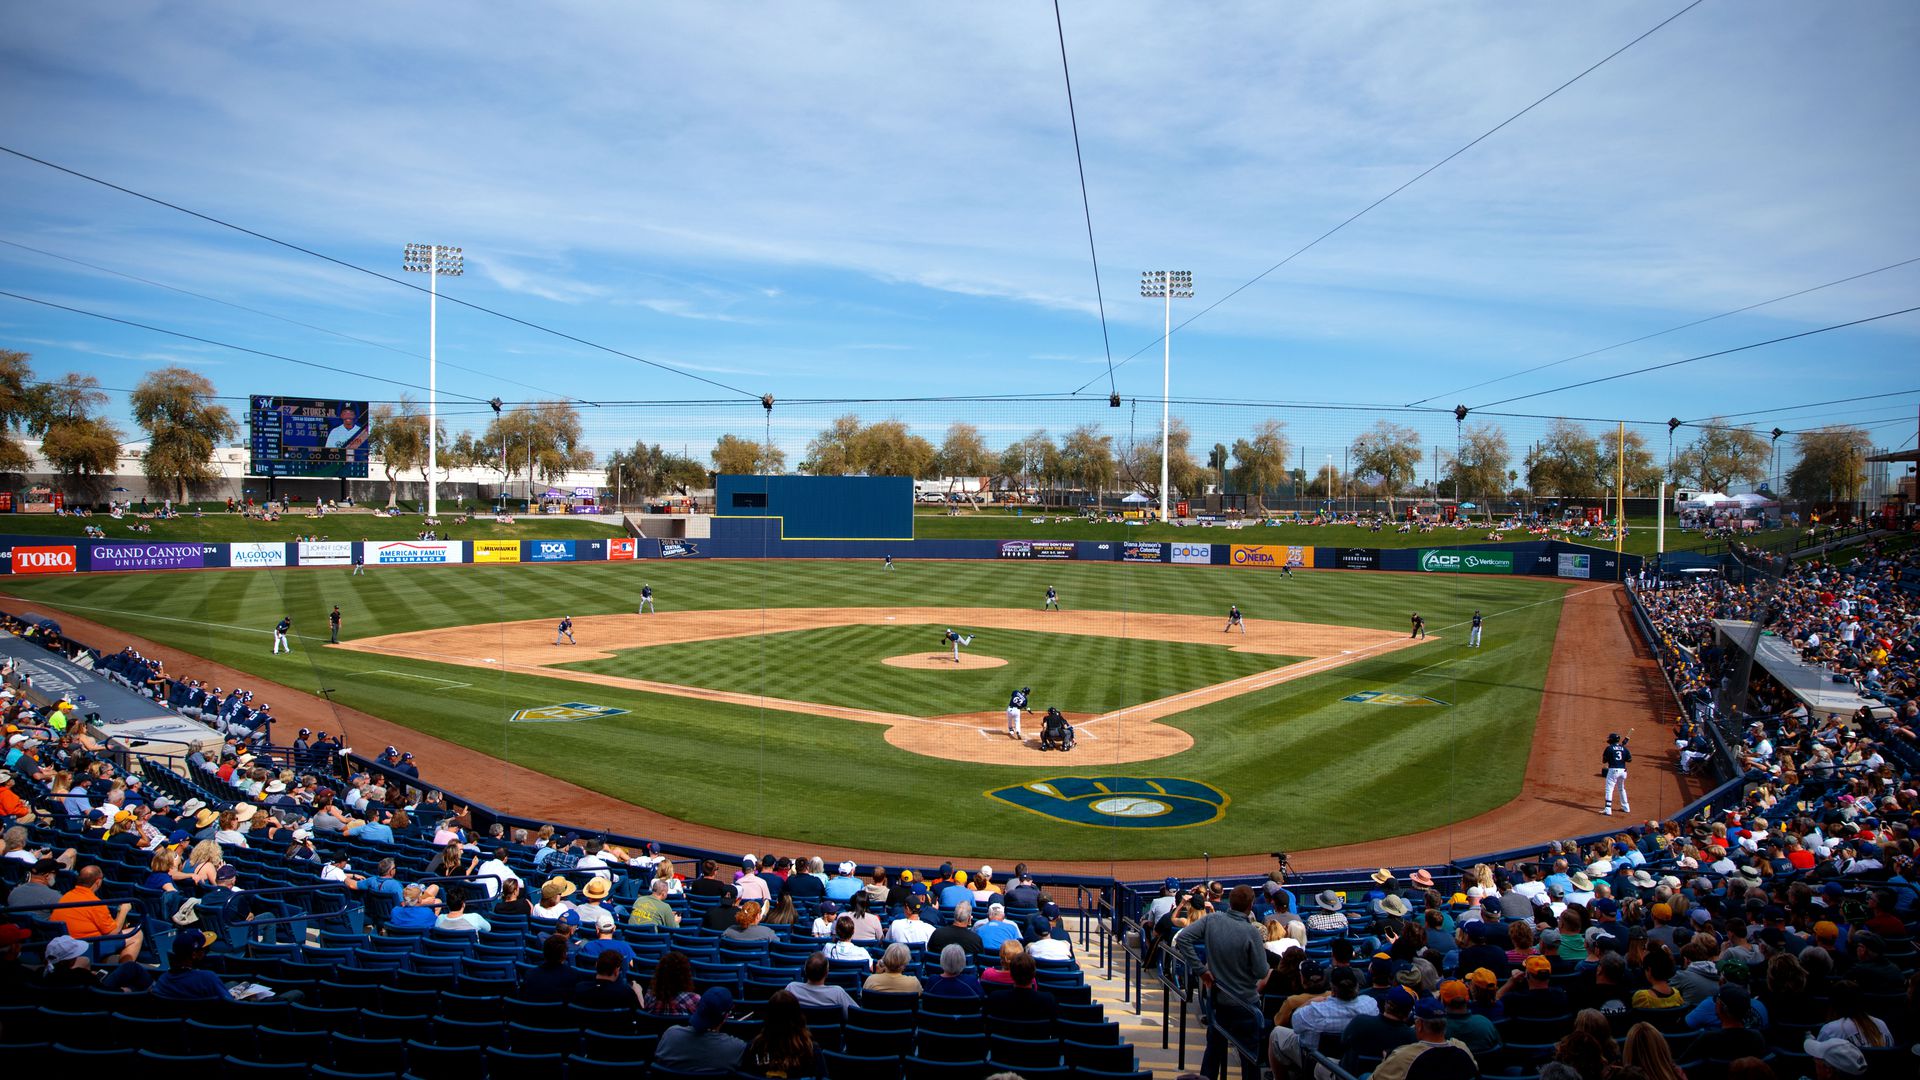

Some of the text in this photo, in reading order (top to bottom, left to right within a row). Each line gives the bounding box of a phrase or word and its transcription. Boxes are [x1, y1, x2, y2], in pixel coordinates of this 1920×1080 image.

[302, 407, 326, 417] STOKES
[255, 463, 269, 473] Lite
[576, 488, 593, 496] GCU
[94, 545, 202, 559] GRAND CANYON
[540, 543, 567, 553] TOCA
[662, 547, 686, 556] CHAMPIONS
[235, 551, 283, 560] ALGODON
[1234, 549, 1275, 563] ONEIDA
[1288, 549, 1302, 561] 25
[1428, 555, 1460, 565] ACP
[115, 558, 184, 567] UNIVERSITY
[1480, 558, 1510, 566] Verticomm
[1615, 750, 1623, 761] 3
